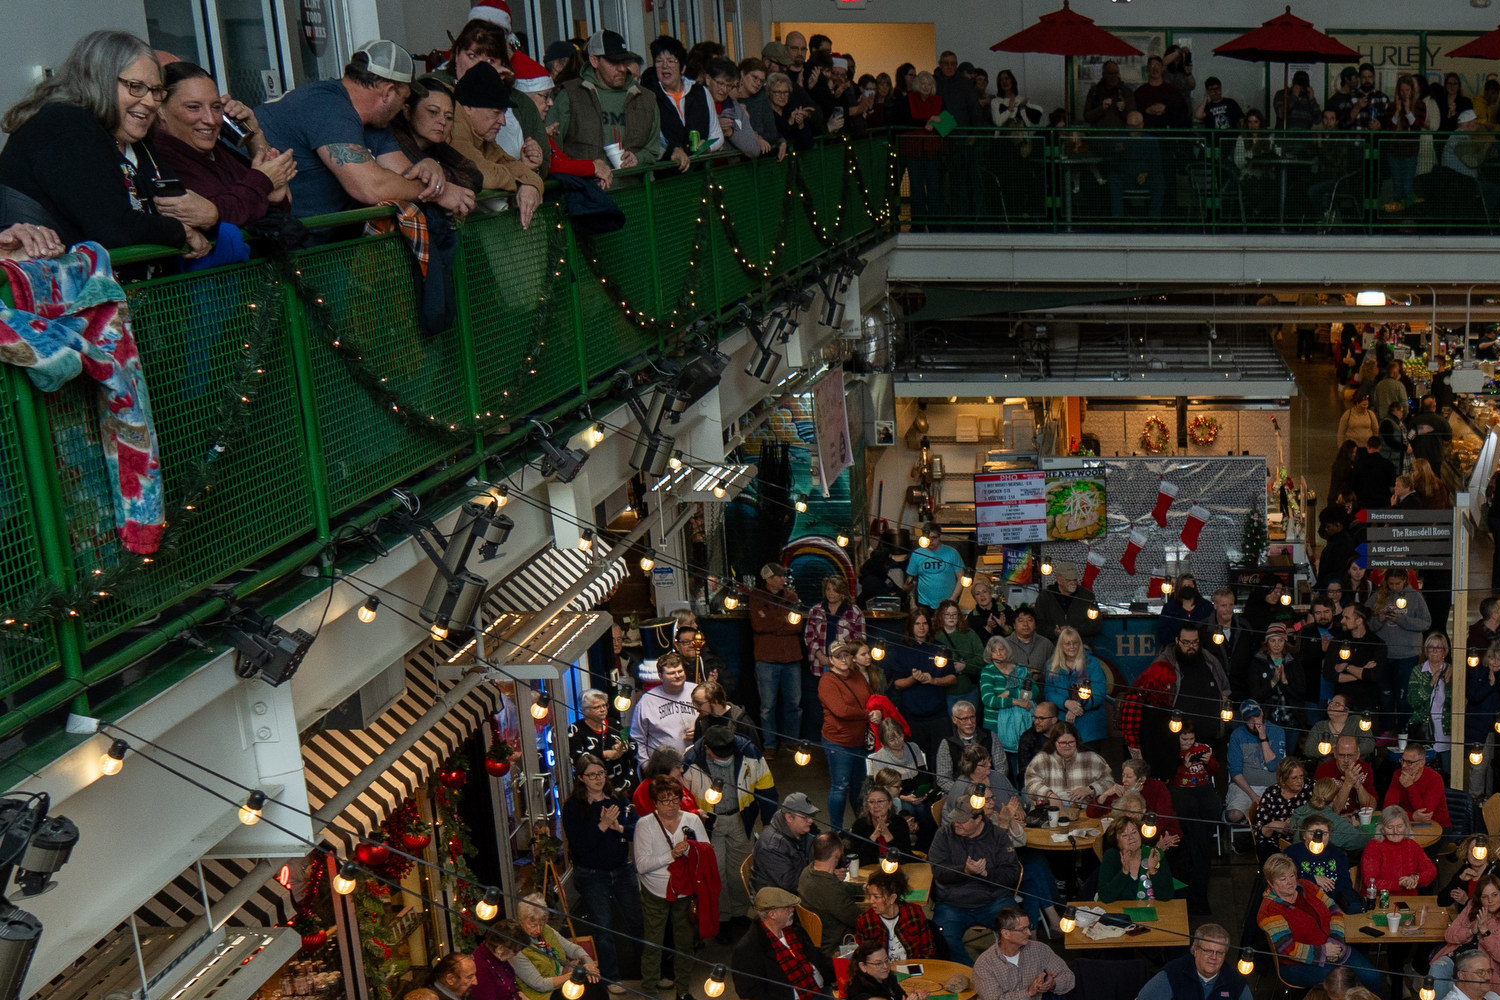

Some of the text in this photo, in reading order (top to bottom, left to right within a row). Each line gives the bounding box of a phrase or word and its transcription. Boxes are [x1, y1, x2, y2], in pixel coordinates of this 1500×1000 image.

[1357, 45, 1441, 67] HURLEY
[1045, 469, 1105, 479] HEARTWOOD
[1392, 527, 1450, 538] The Ramsdell Room
[924, 561, 943, 570] DTF
